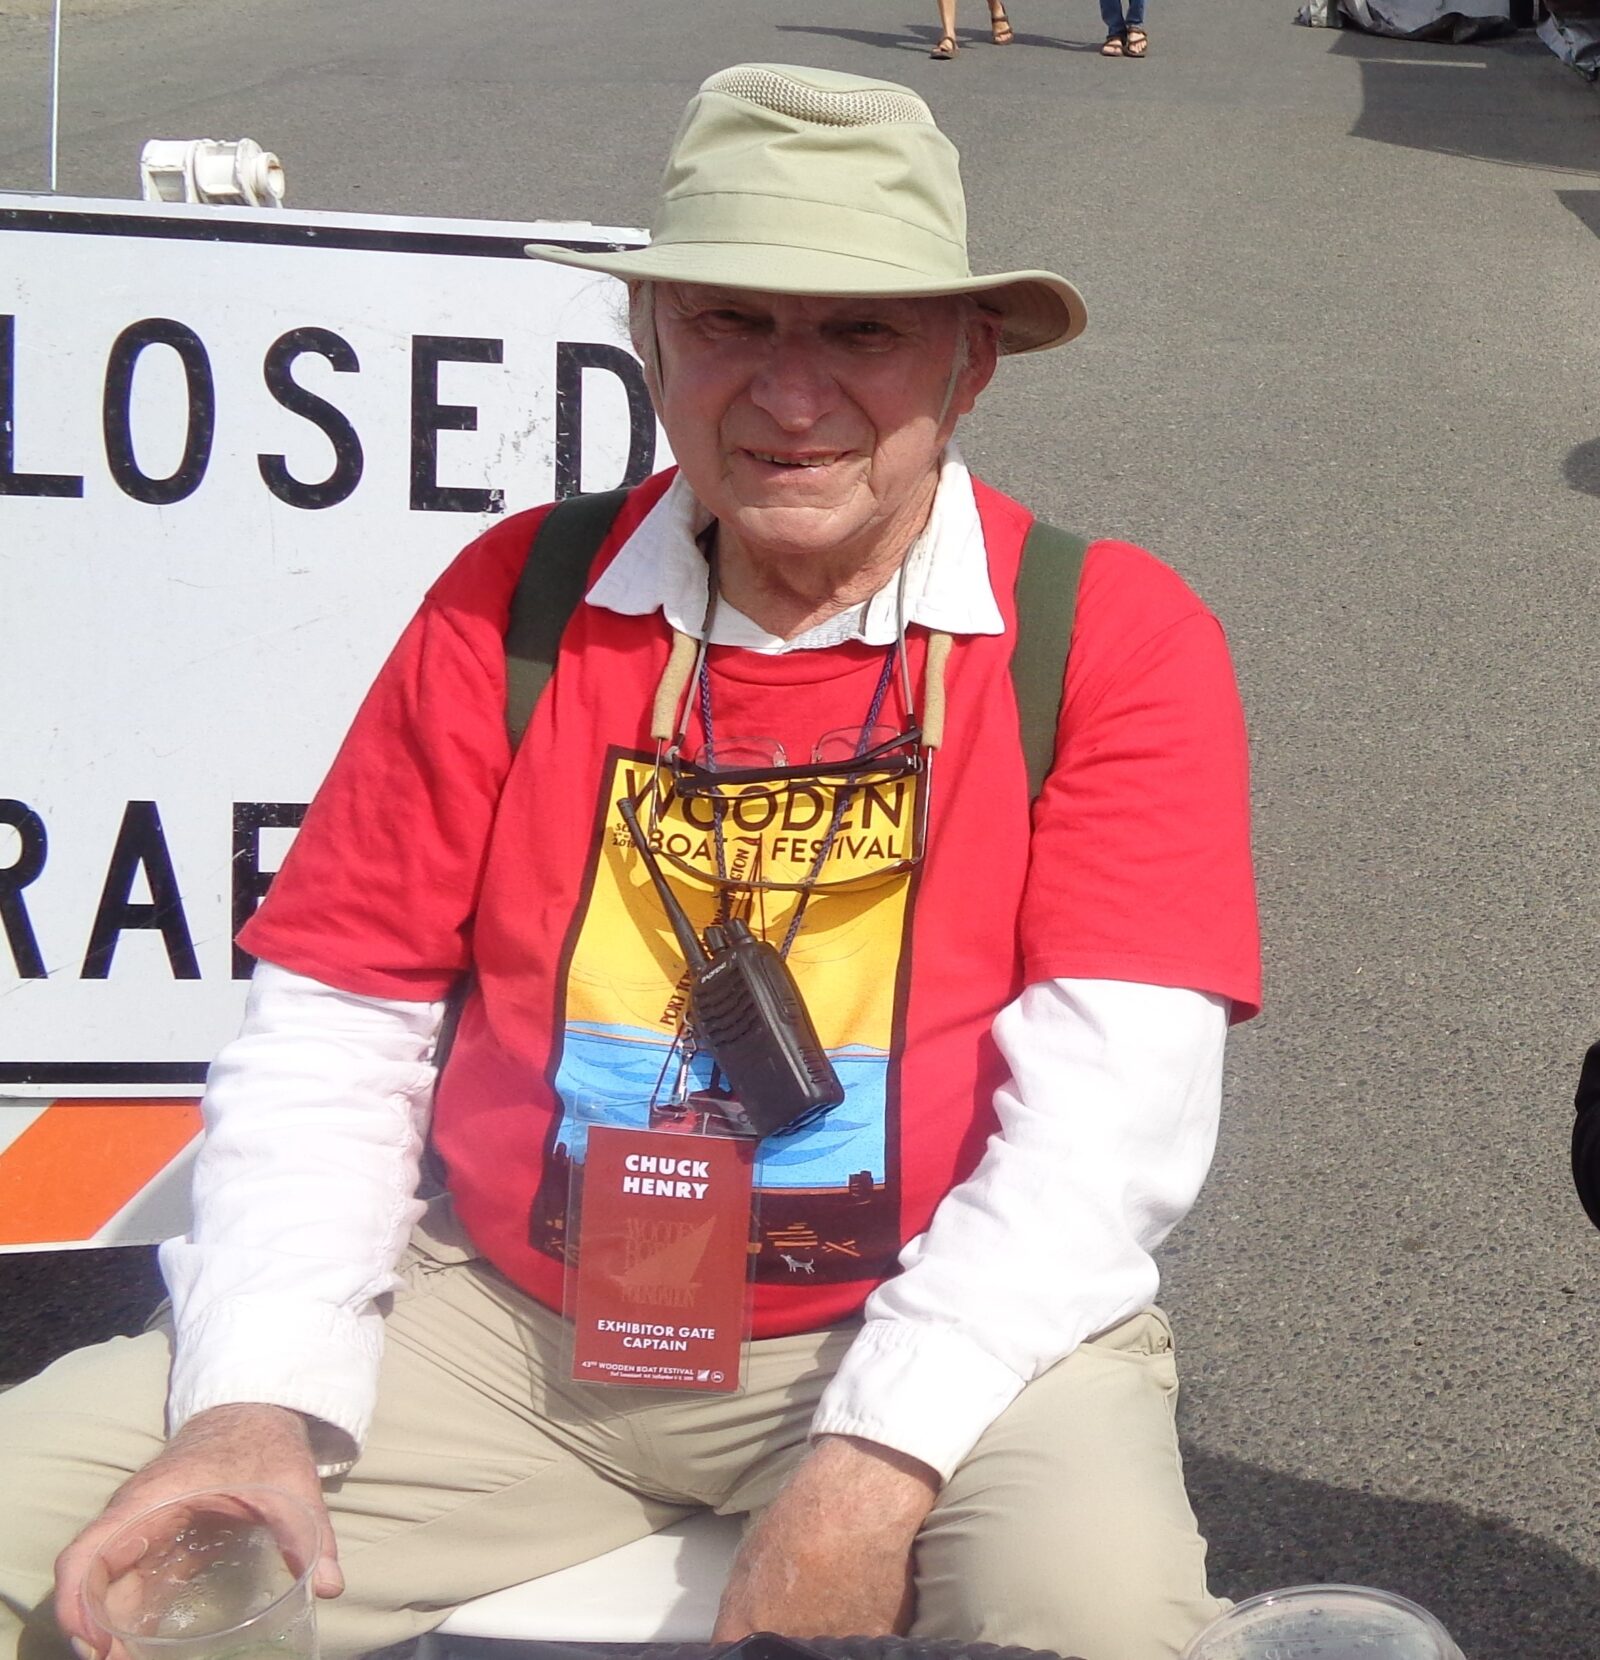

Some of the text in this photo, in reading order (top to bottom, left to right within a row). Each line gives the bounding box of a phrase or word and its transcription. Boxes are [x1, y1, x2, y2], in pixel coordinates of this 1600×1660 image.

[0, 314, 657, 513] LOSED
[771, 834, 902, 864] FESTIVAL
[625, 1154, 709, 1178] CHUCK
[623, 1176, 709, 1200] HENRY
[597, 1319, 716, 1340] EXHIBITOR GATE
[623, 1336, 688, 1351] CAPTAIN
[598, 1362, 636, 1372] WOODEN
[636, 1365, 658, 1373] BOAT
[658, 1366, 695, 1376] FESTIVAL
